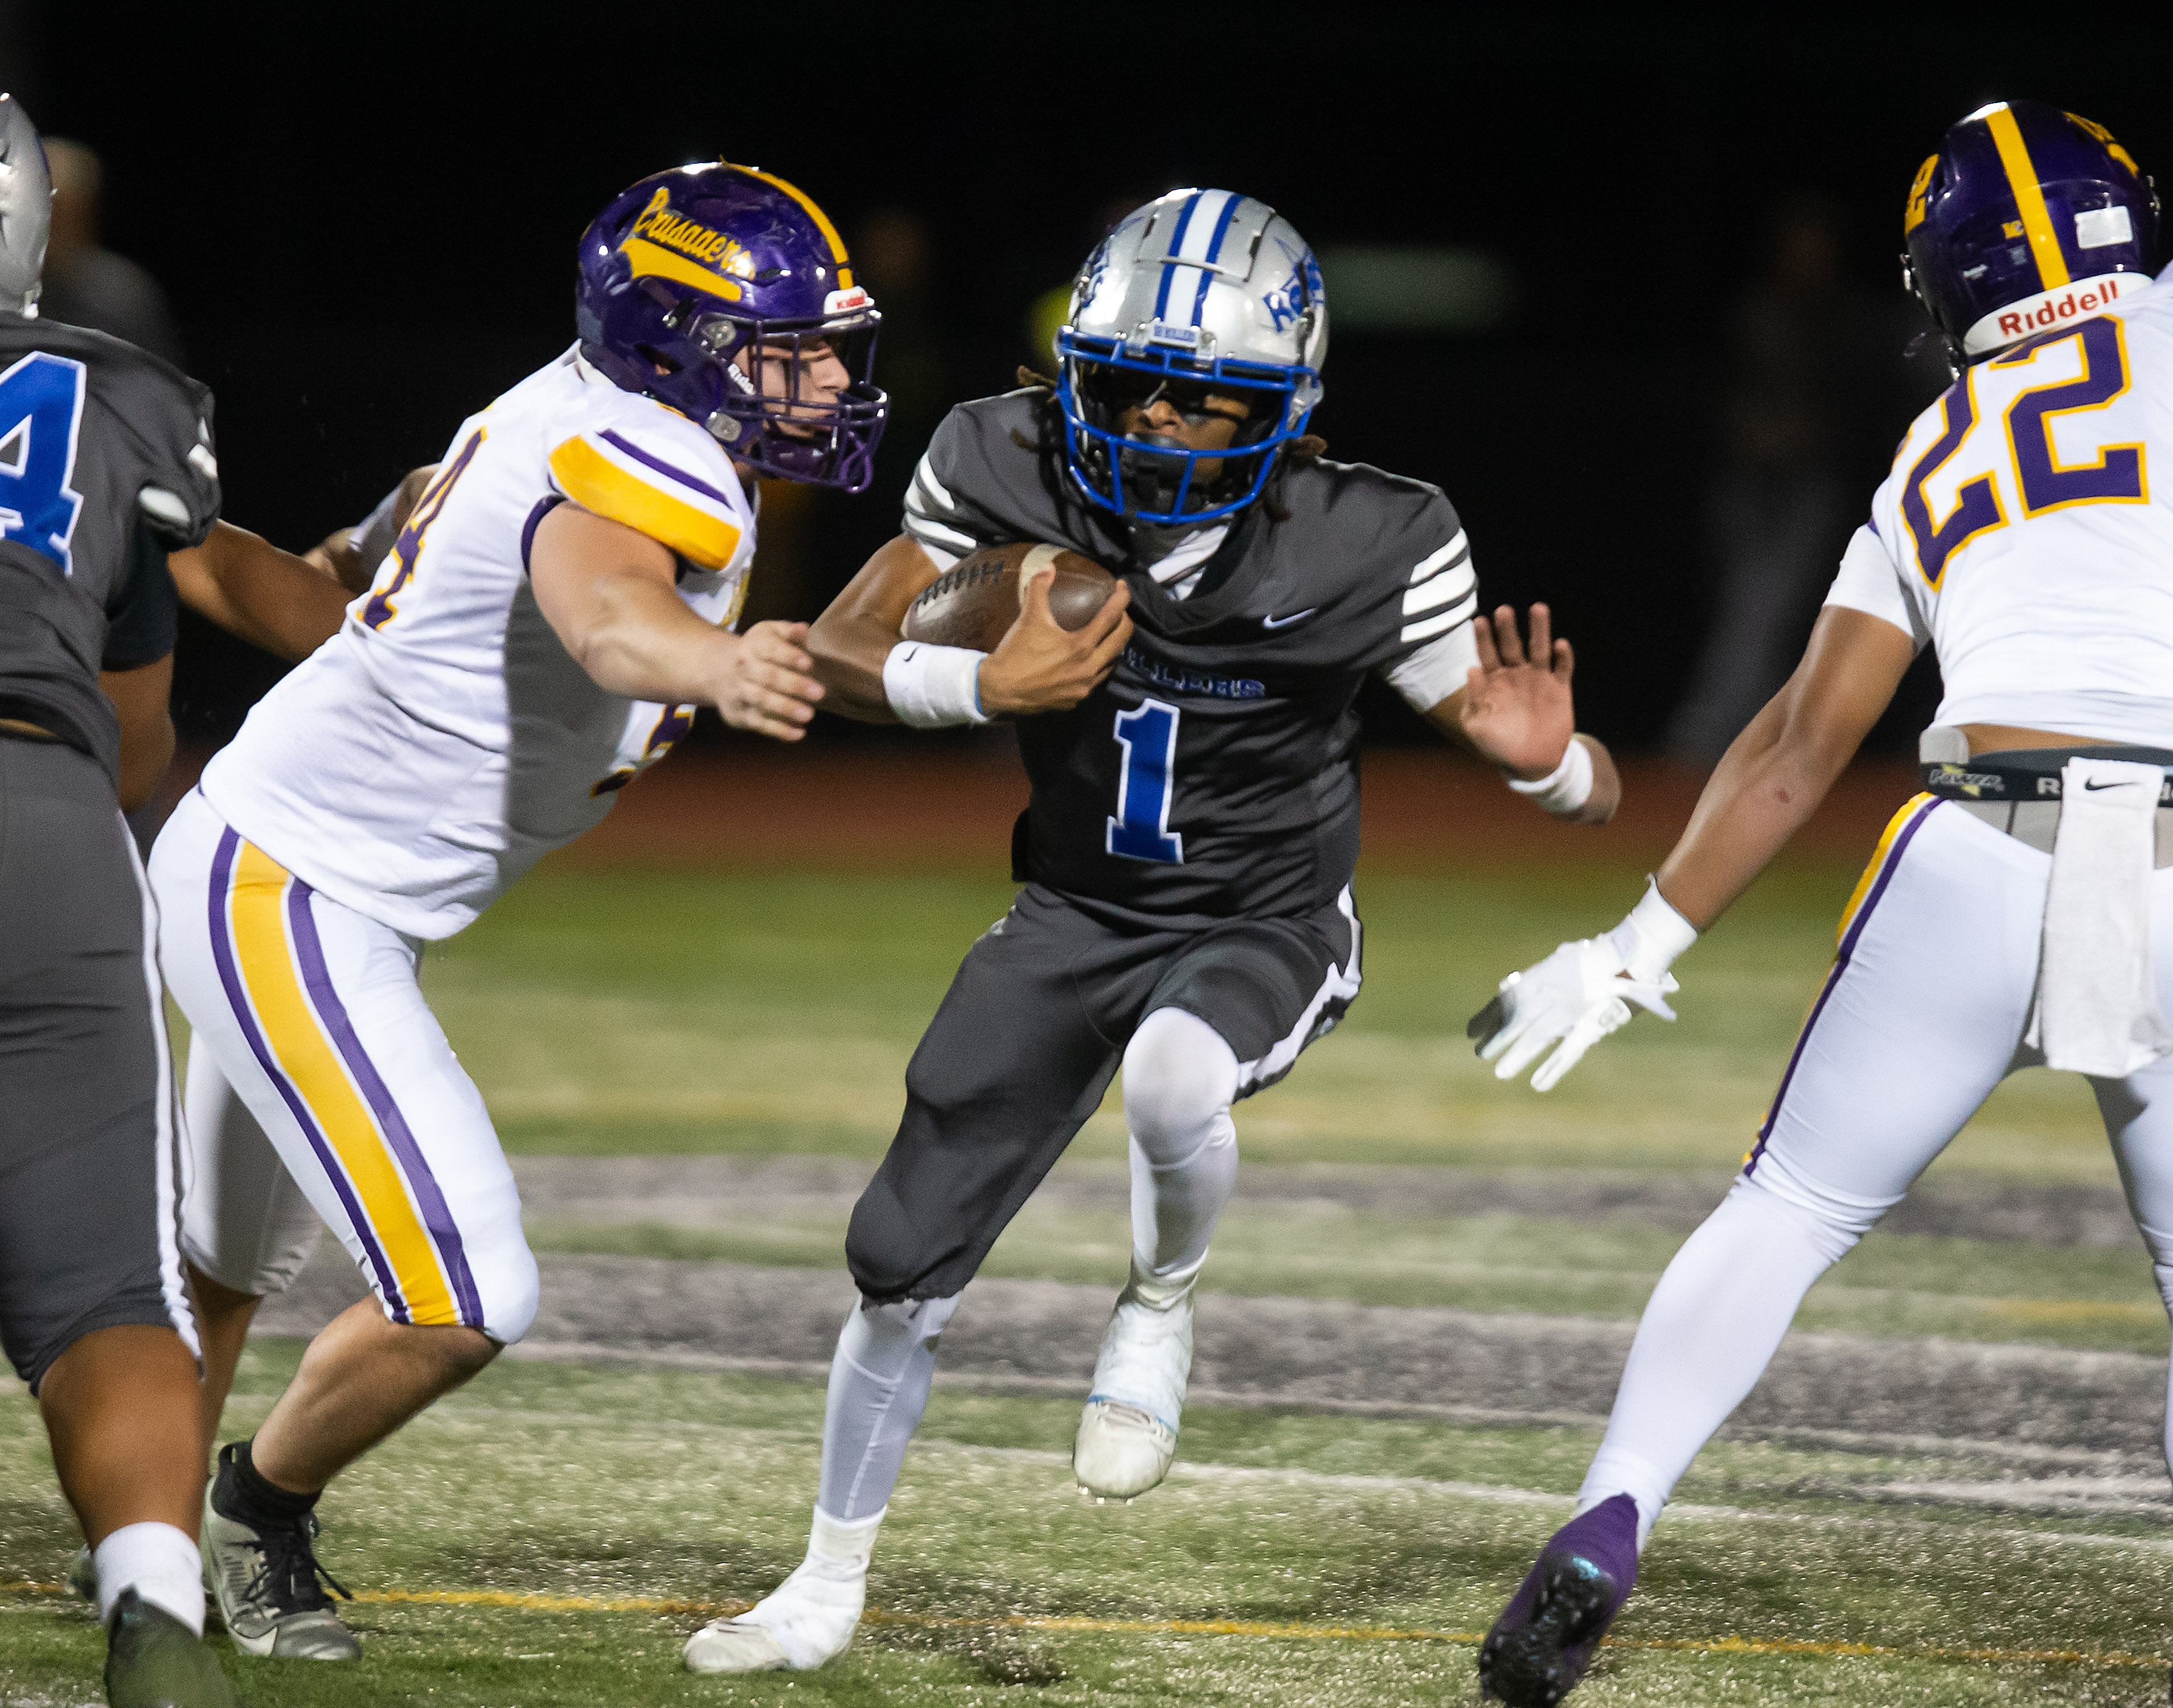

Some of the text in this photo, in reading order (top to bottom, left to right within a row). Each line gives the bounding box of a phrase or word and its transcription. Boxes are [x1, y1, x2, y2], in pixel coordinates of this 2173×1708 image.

[1998, 280, 2118, 336] Riddell
[1892, 314, 2150, 593] 22
[1106, 697, 1184, 864] 1
